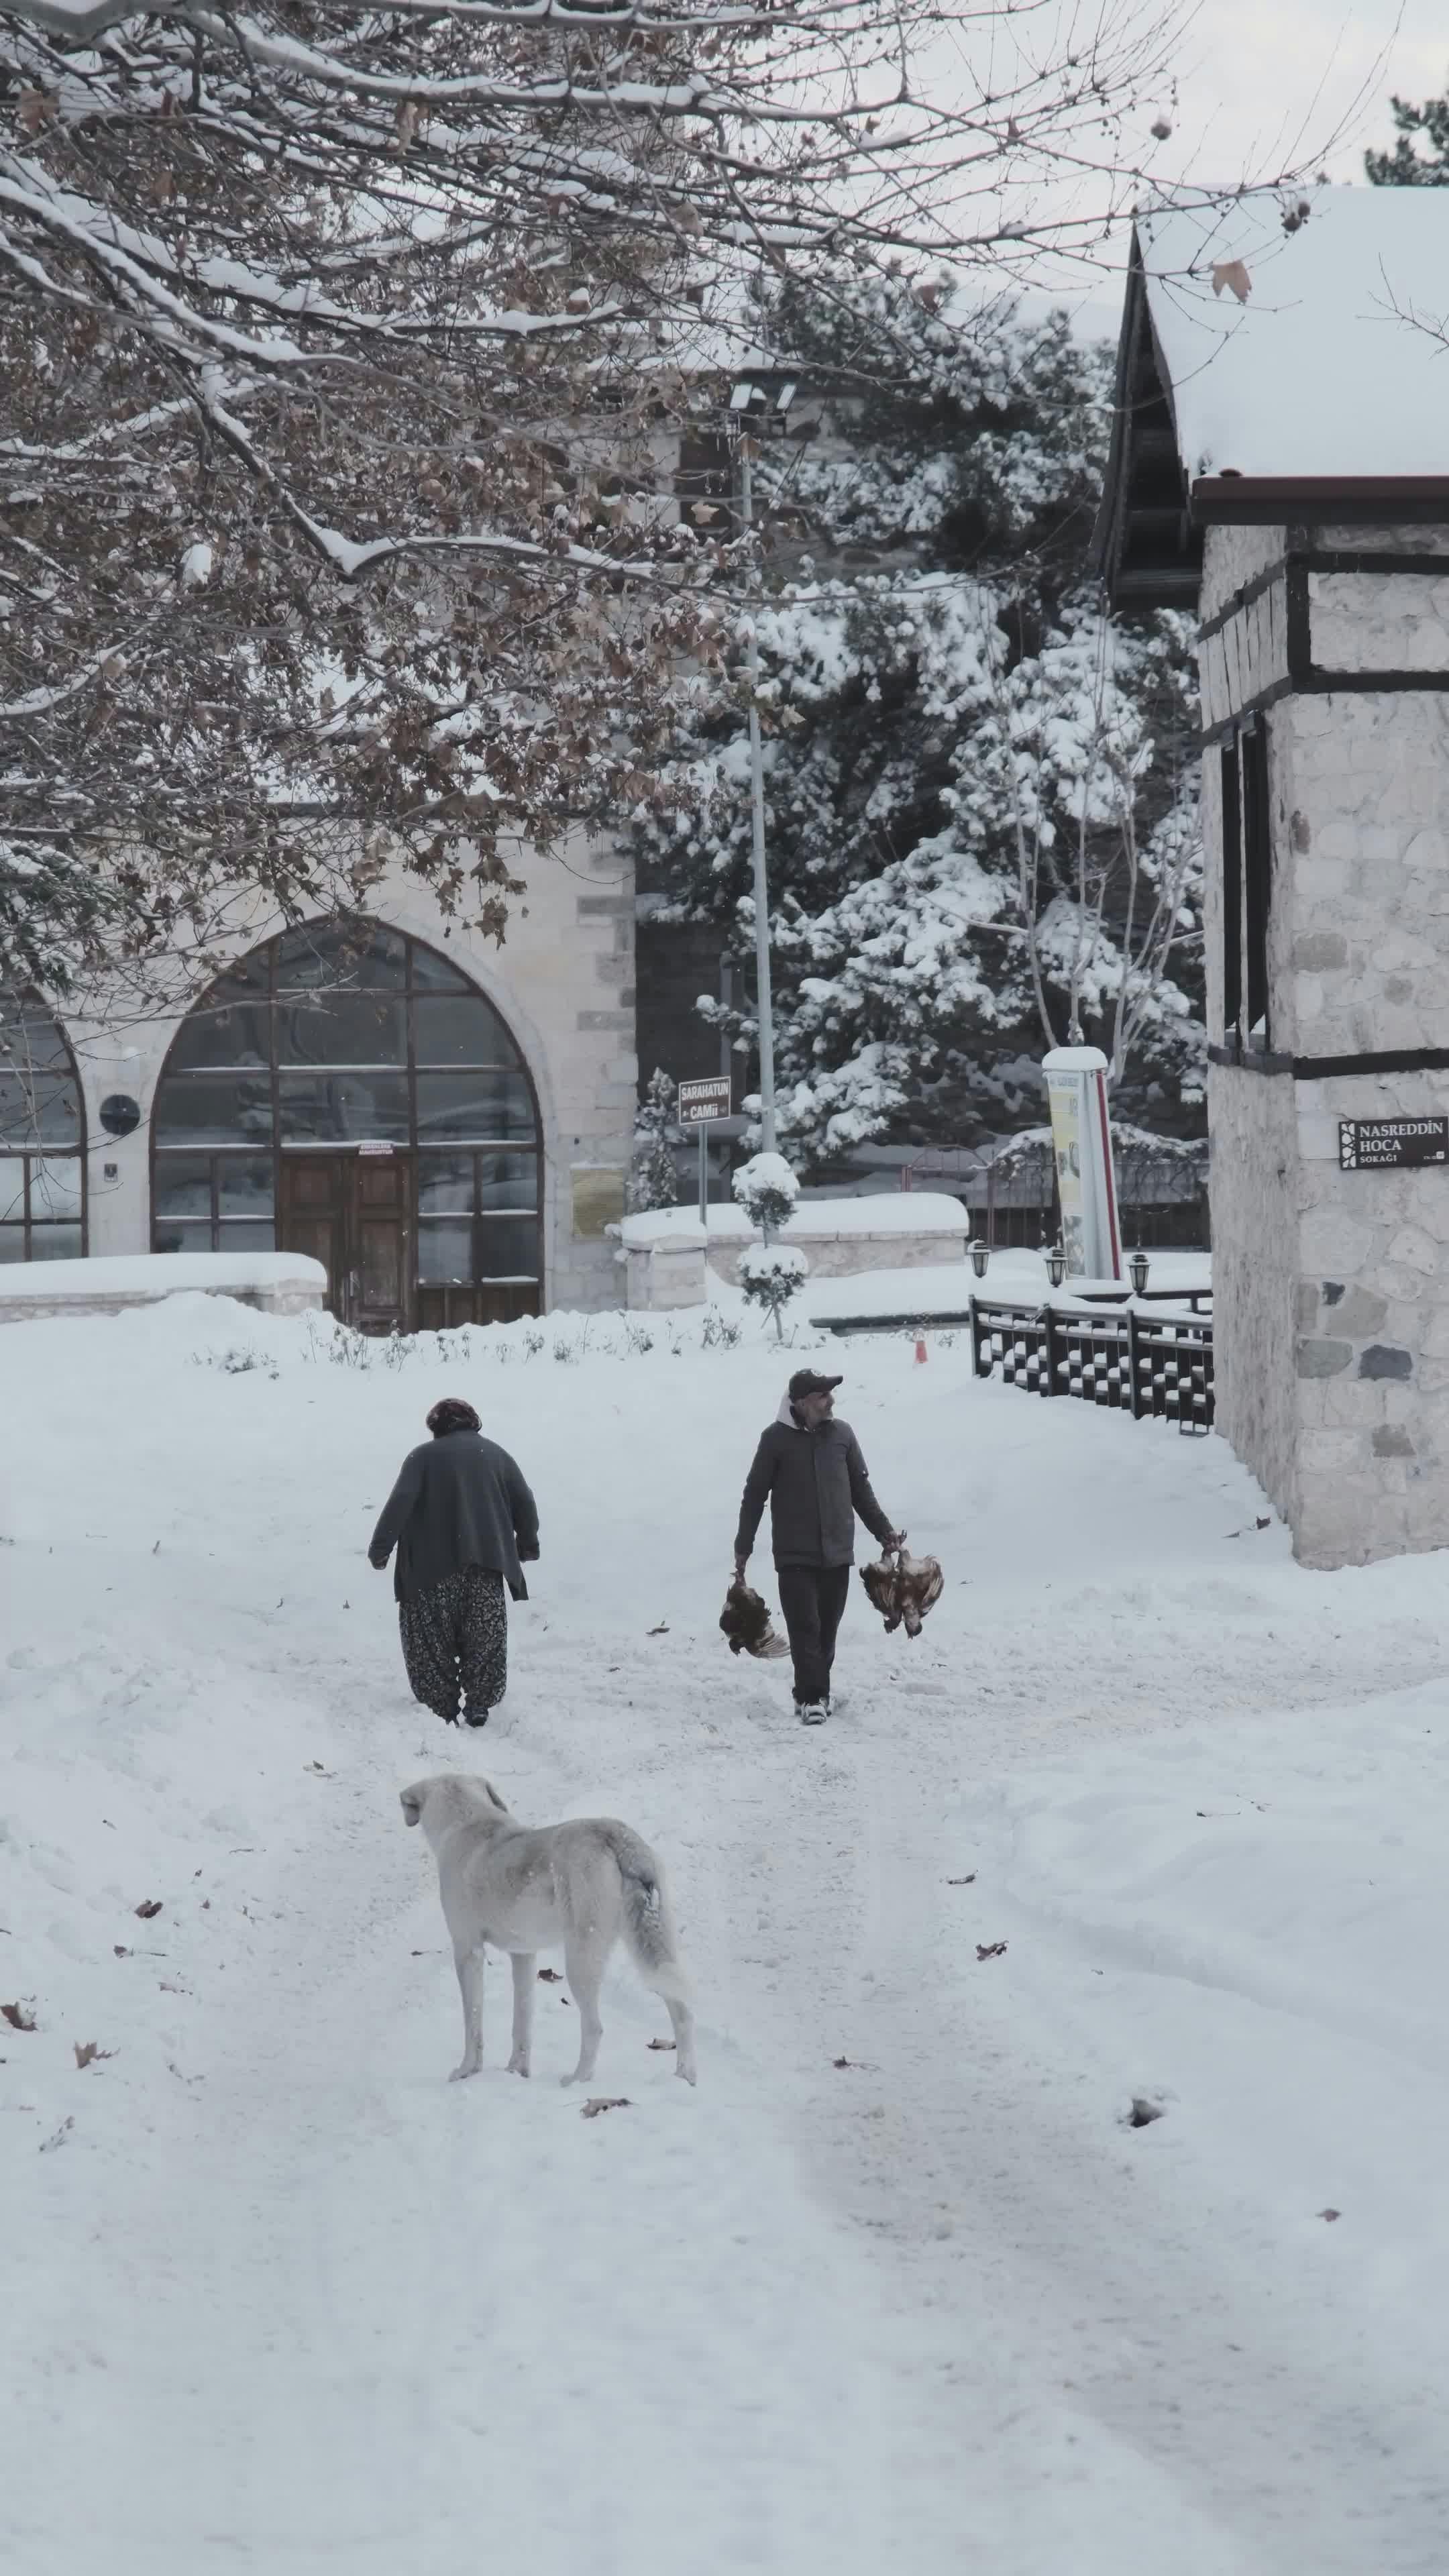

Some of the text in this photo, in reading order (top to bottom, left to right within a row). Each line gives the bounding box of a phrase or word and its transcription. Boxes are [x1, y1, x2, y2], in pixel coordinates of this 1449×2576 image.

[682, 1082, 729, 1100] SARAHATUN
[1360, 1120, 1444, 1137] NASREDDİN
[1360, 1139, 1402, 1152] HOCA
[1360, 1153, 1397, 1163] SOKAĞI
